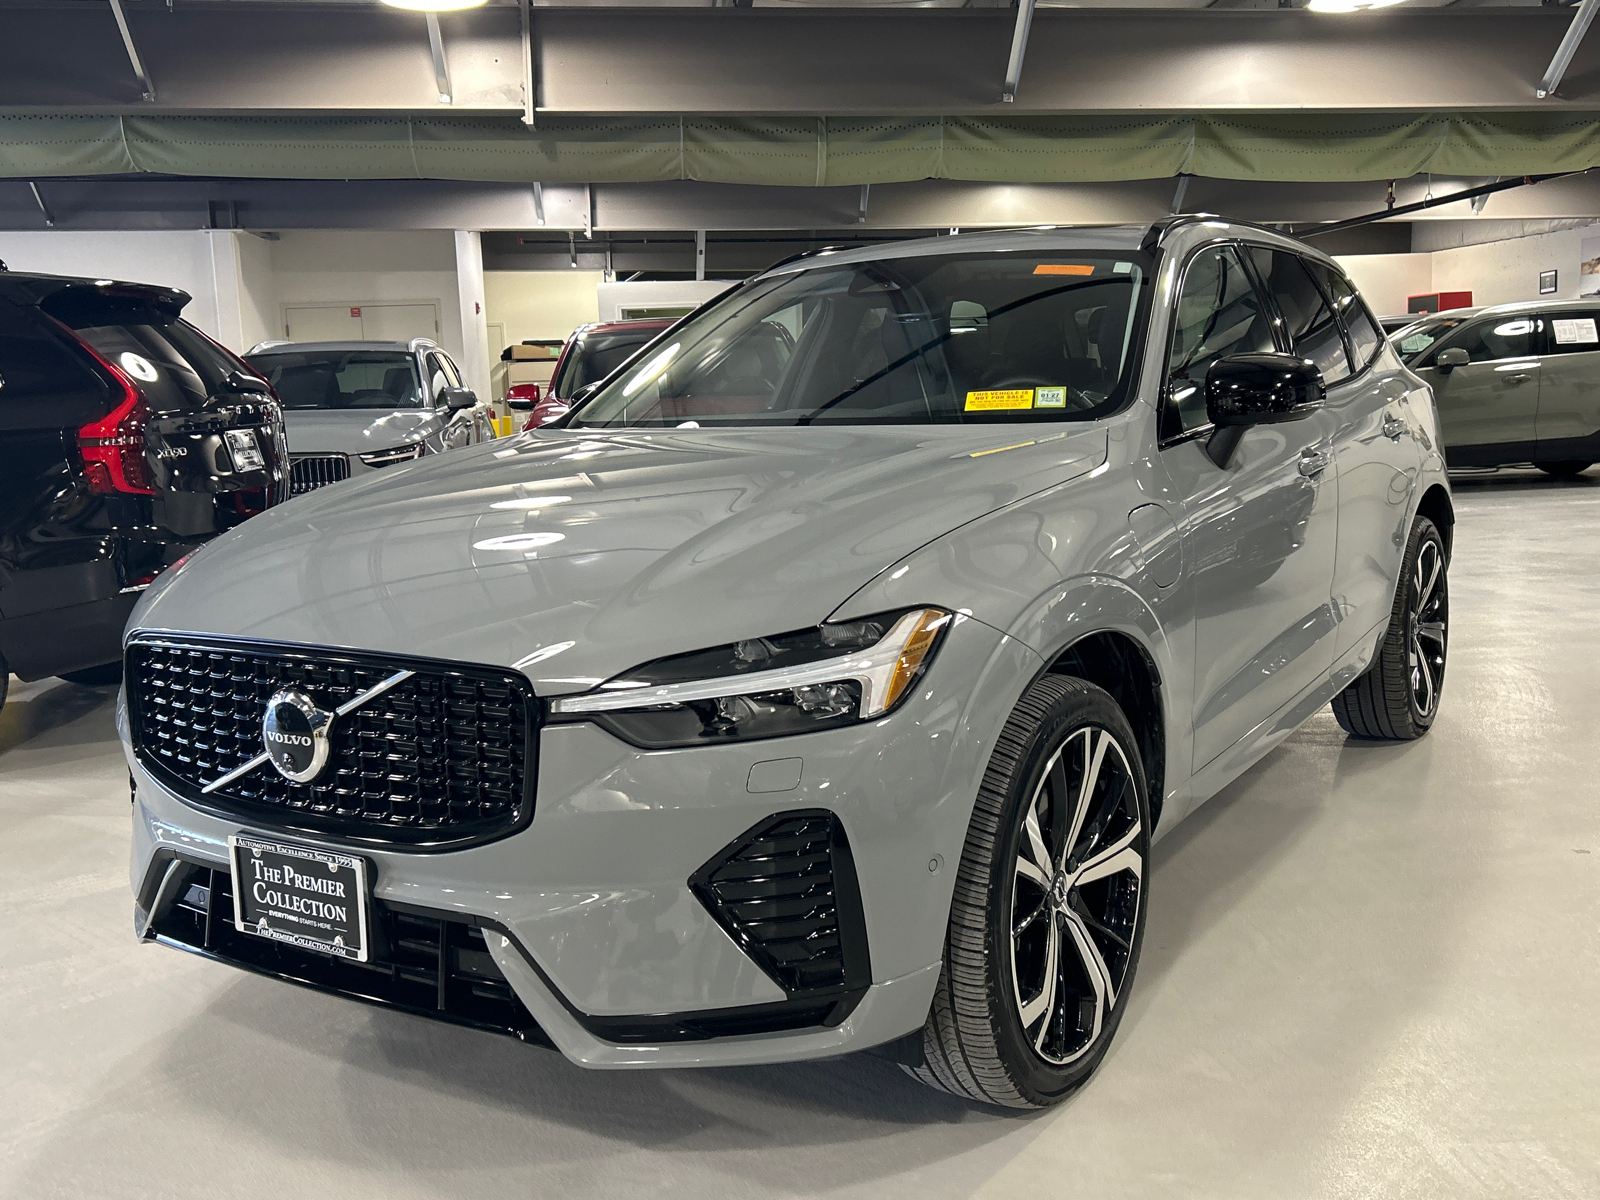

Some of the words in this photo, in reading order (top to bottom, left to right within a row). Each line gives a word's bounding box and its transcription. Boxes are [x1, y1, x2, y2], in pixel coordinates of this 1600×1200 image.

[267, 731, 312, 747] VOLVO
[238, 838, 276, 852] AUTOMOTIVE
[277, 845, 315, 858] EXCELLENCE
[335, 856, 352, 867] 1995
[251, 859, 282, 884] THE
[282, 865, 346, 898] PREMIER
[253, 881, 347, 922] COLLECTION
[268, 910, 299, 922] EVERYTHING
[299, 917, 317, 927] STARTS
